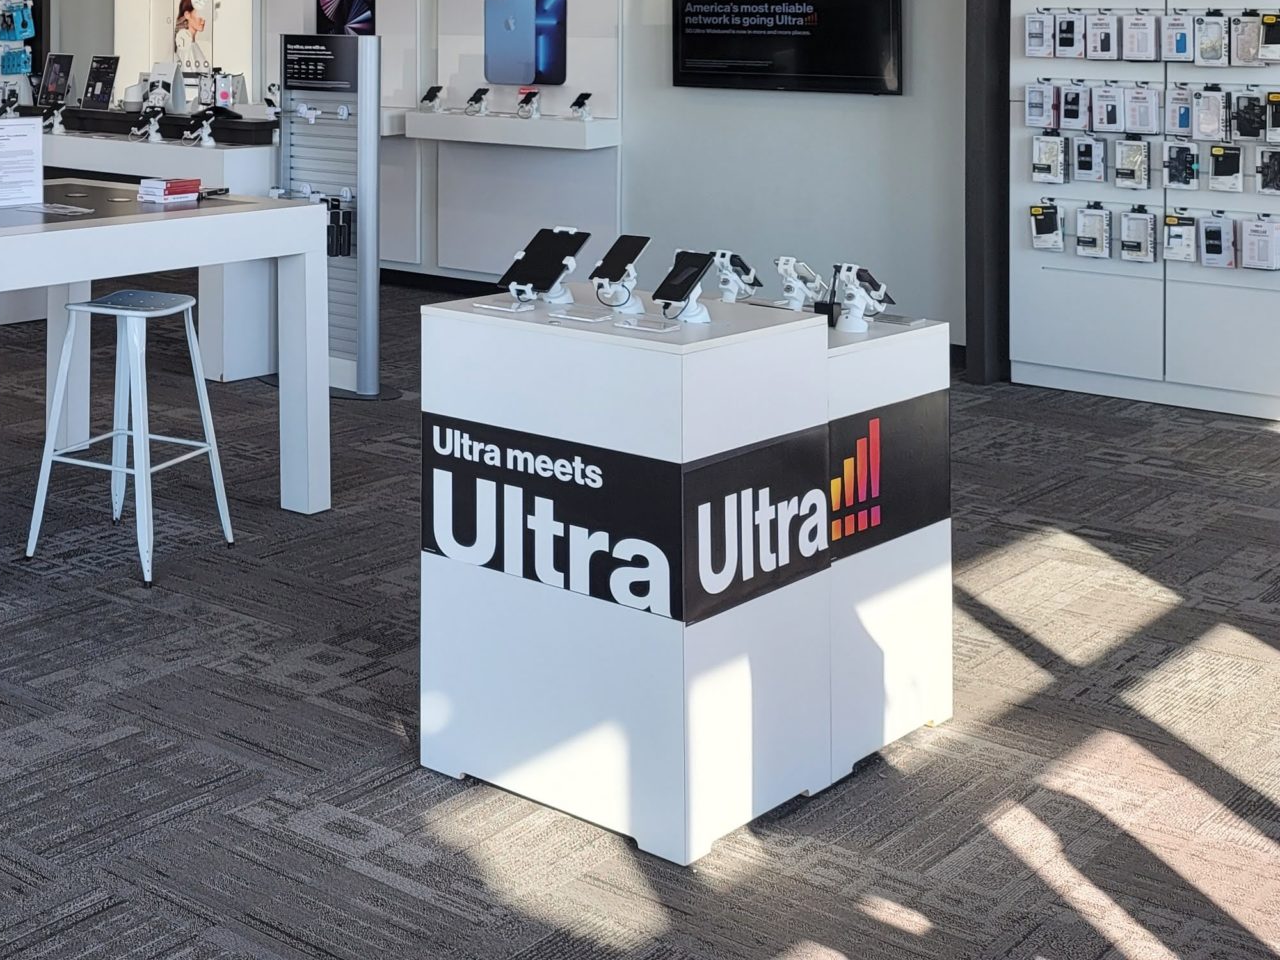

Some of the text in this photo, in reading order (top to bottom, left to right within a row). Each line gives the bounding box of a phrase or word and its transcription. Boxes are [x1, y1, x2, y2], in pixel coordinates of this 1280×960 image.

[685, 2, 814, 13] America's most reliable
[685, 14, 804, 27] network is going Ultra
[433, 425, 603, 489] Ultra meets
[433, 467, 673, 619] Ultra
